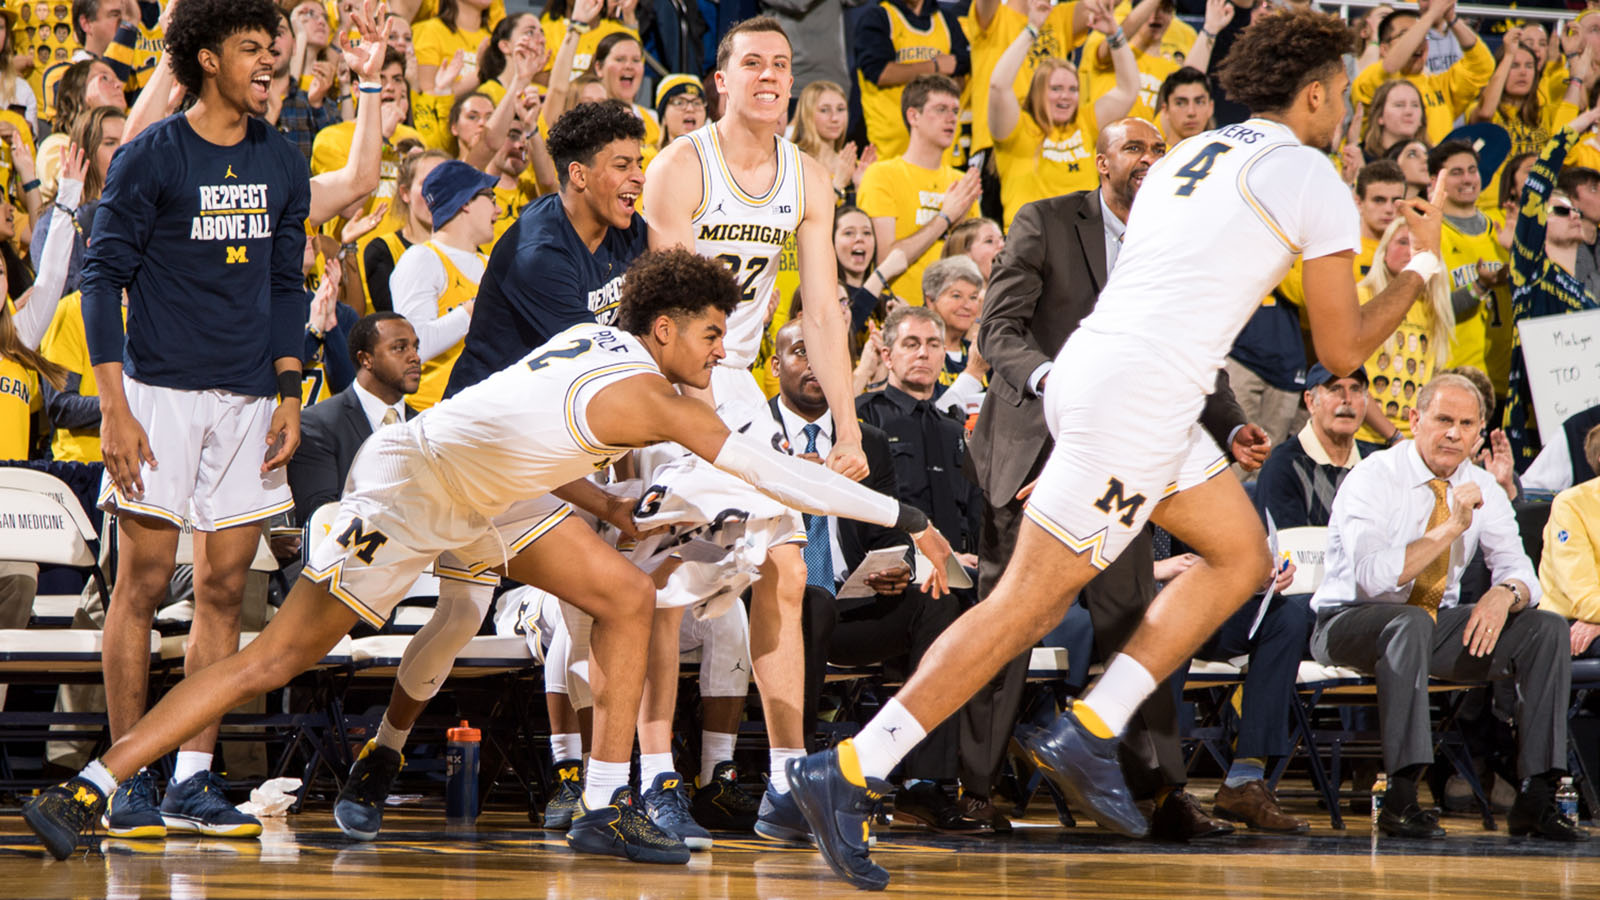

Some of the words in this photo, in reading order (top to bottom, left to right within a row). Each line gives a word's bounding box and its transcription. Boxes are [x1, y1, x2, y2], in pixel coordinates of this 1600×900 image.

[1173, 141, 1235, 198] 4
[199, 184, 268, 210] RE2PECT
[190, 215, 247, 240] ABOVE
[247, 213, 272, 239] ALL
[698, 224, 791, 246] MICHIGAN
[526, 338, 593, 372] 2
[1093, 475, 1147, 528] M
[18, 514, 65, 530] MEDICINE
[335, 515, 389, 567] M
[558, 766, 579, 782] M
